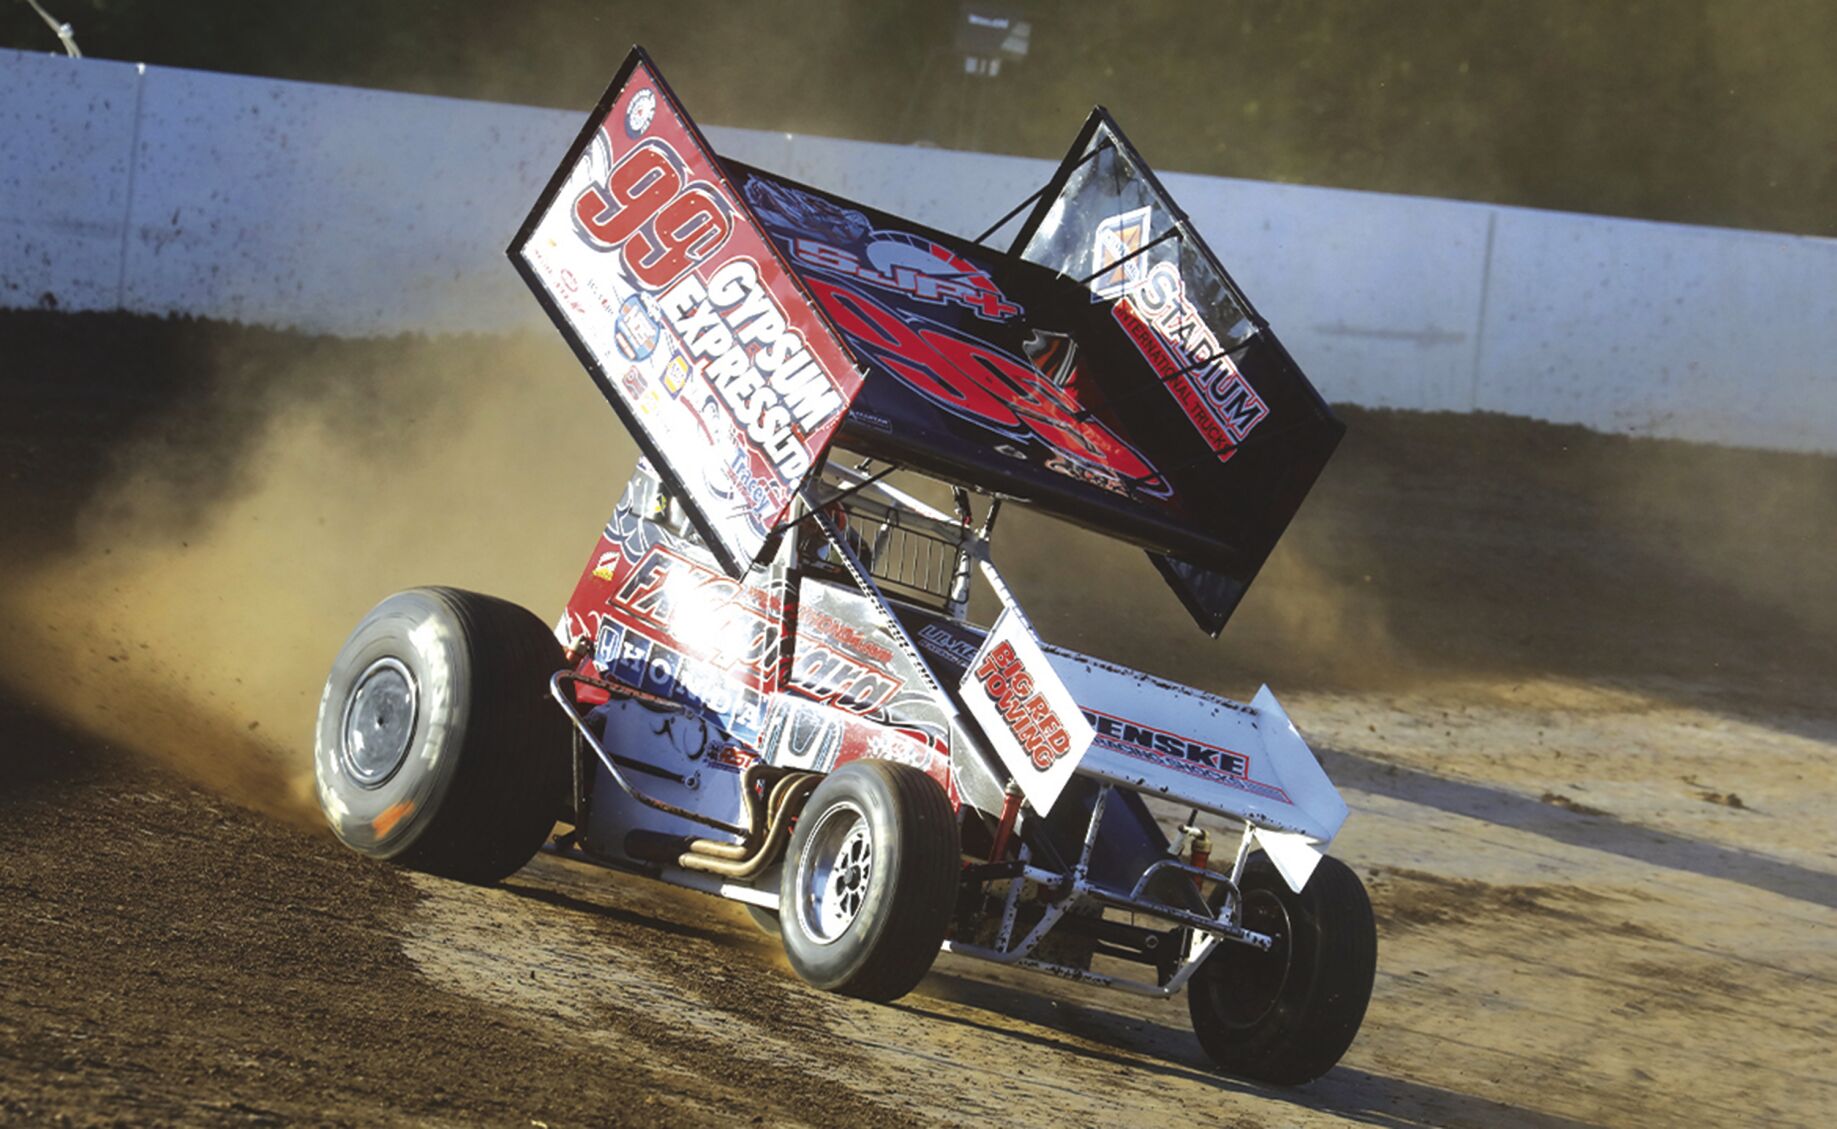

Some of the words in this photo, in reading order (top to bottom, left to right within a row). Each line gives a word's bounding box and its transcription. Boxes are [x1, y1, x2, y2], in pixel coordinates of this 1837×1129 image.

[657, 273, 791, 443] EXPRESS
[706, 260, 844, 435] GYPSUM
[1137, 267, 1263, 437] STADIUM
[730, 449, 770, 515] Tracey
[976, 656, 1055, 770] TOWING
[991, 641, 1034, 697] BIG
[1025, 693, 1071, 757] RED
